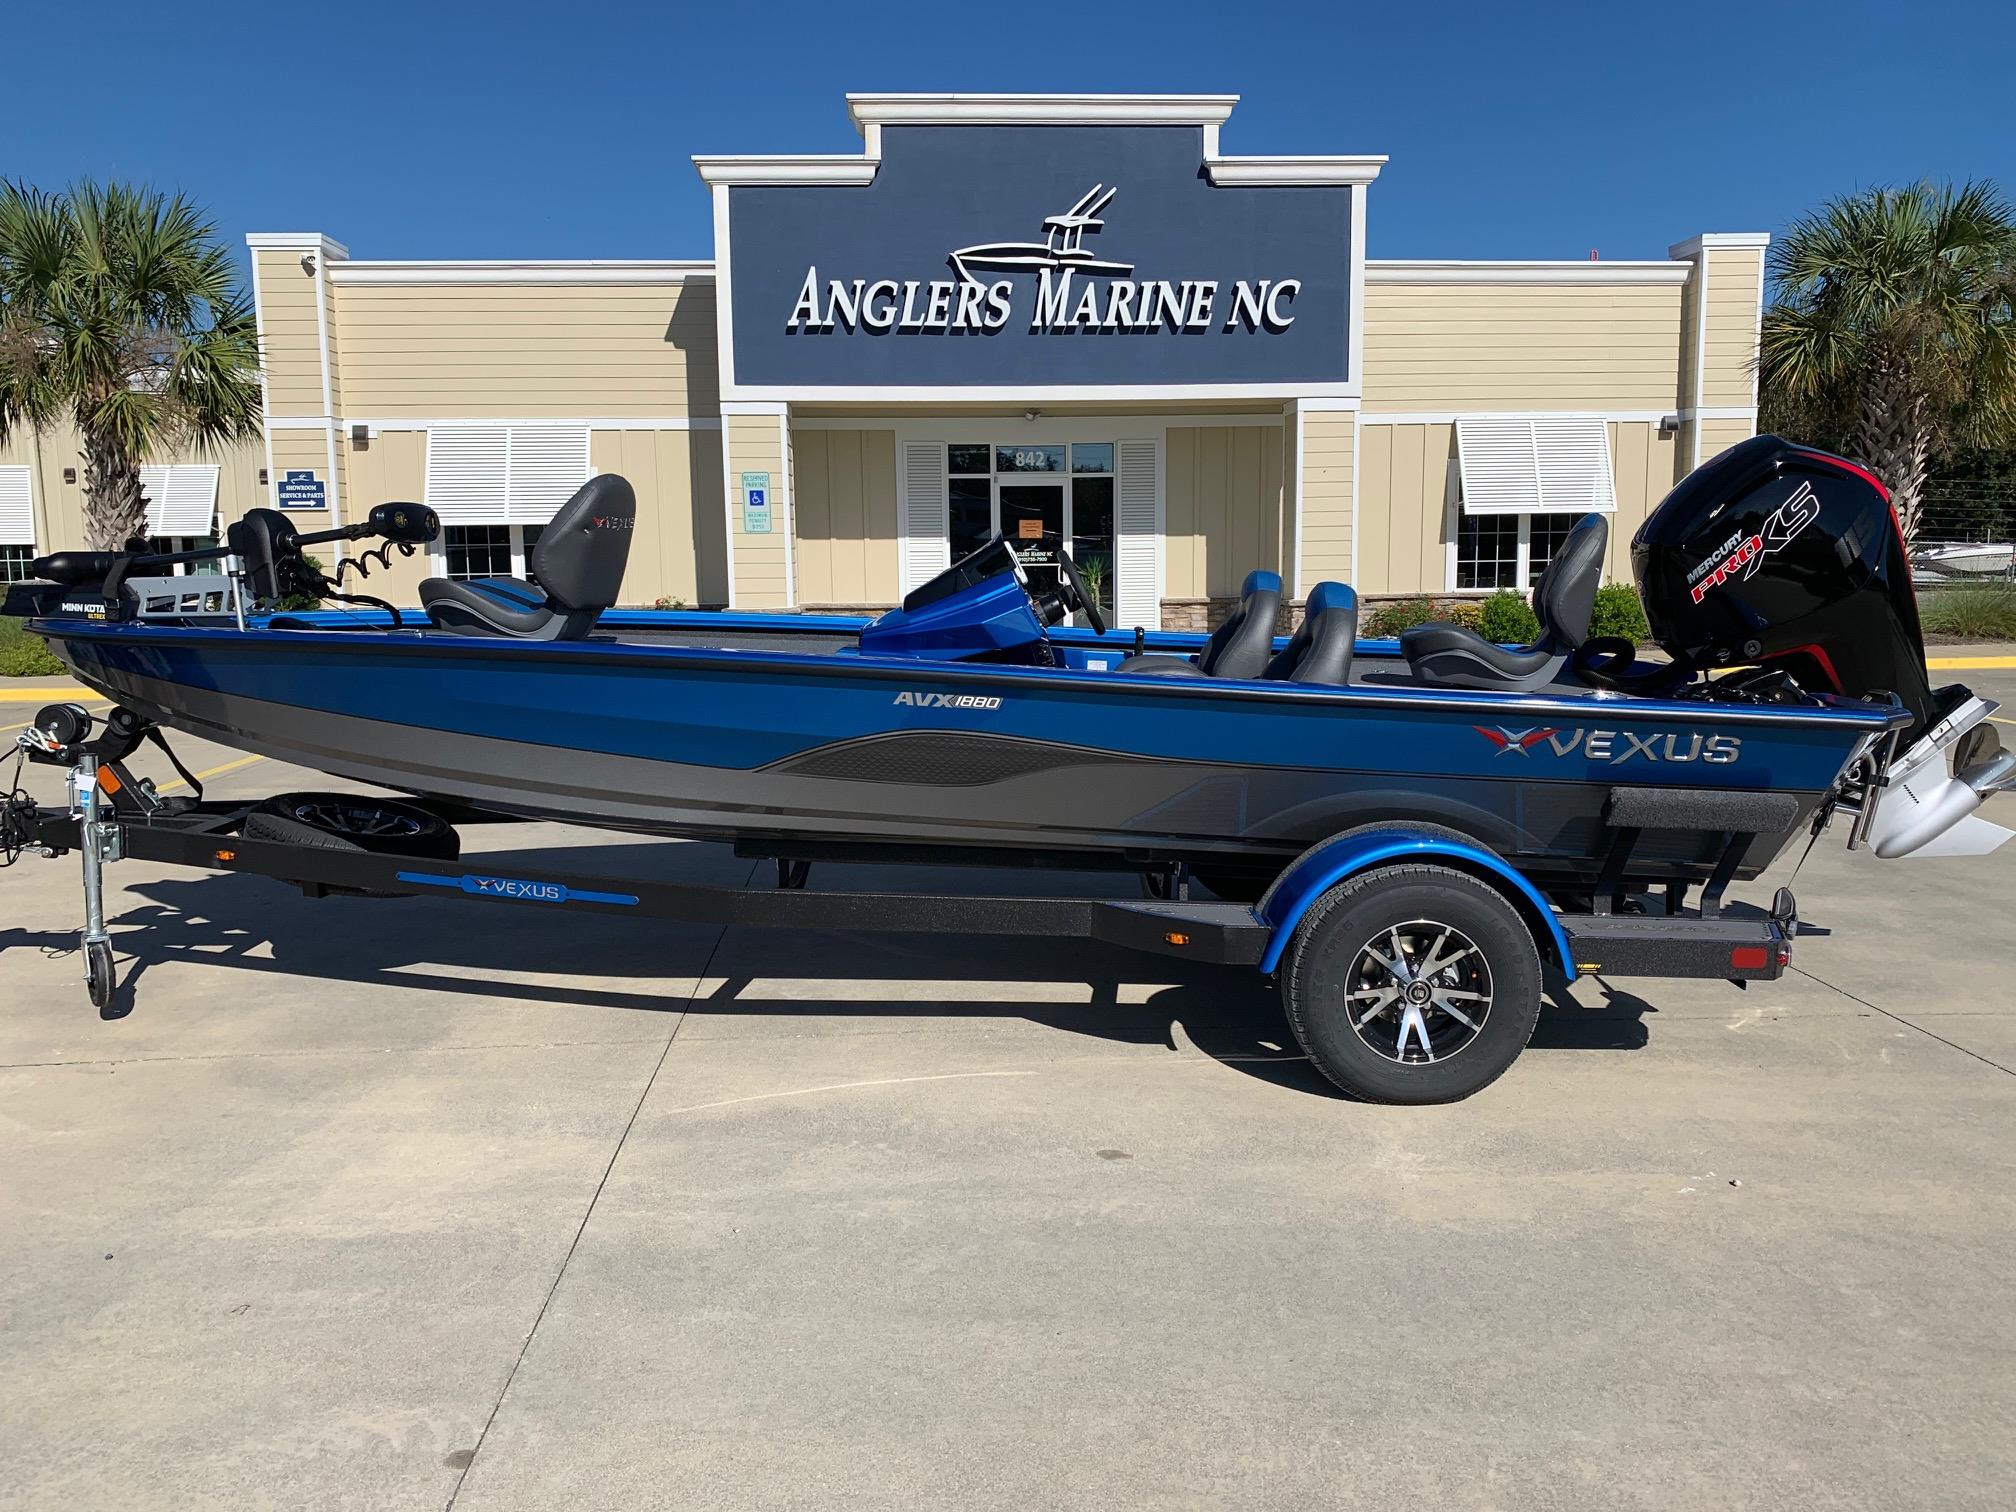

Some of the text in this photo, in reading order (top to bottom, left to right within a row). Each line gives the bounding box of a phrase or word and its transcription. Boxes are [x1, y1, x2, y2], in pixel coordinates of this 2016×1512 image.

[786, 265, 1302, 330] ANGLERS MARINE NC
[1015, 451, 1046, 467] 842
[1686, 529, 1743, 585] MERCURY
[1691, 480, 1820, 605] PRO XS
[62, 602, 106, 613] MINN KOTA
[1542, 727, 1742, 765] VEXUS
[494, 880, 559, 899] VEXUS
